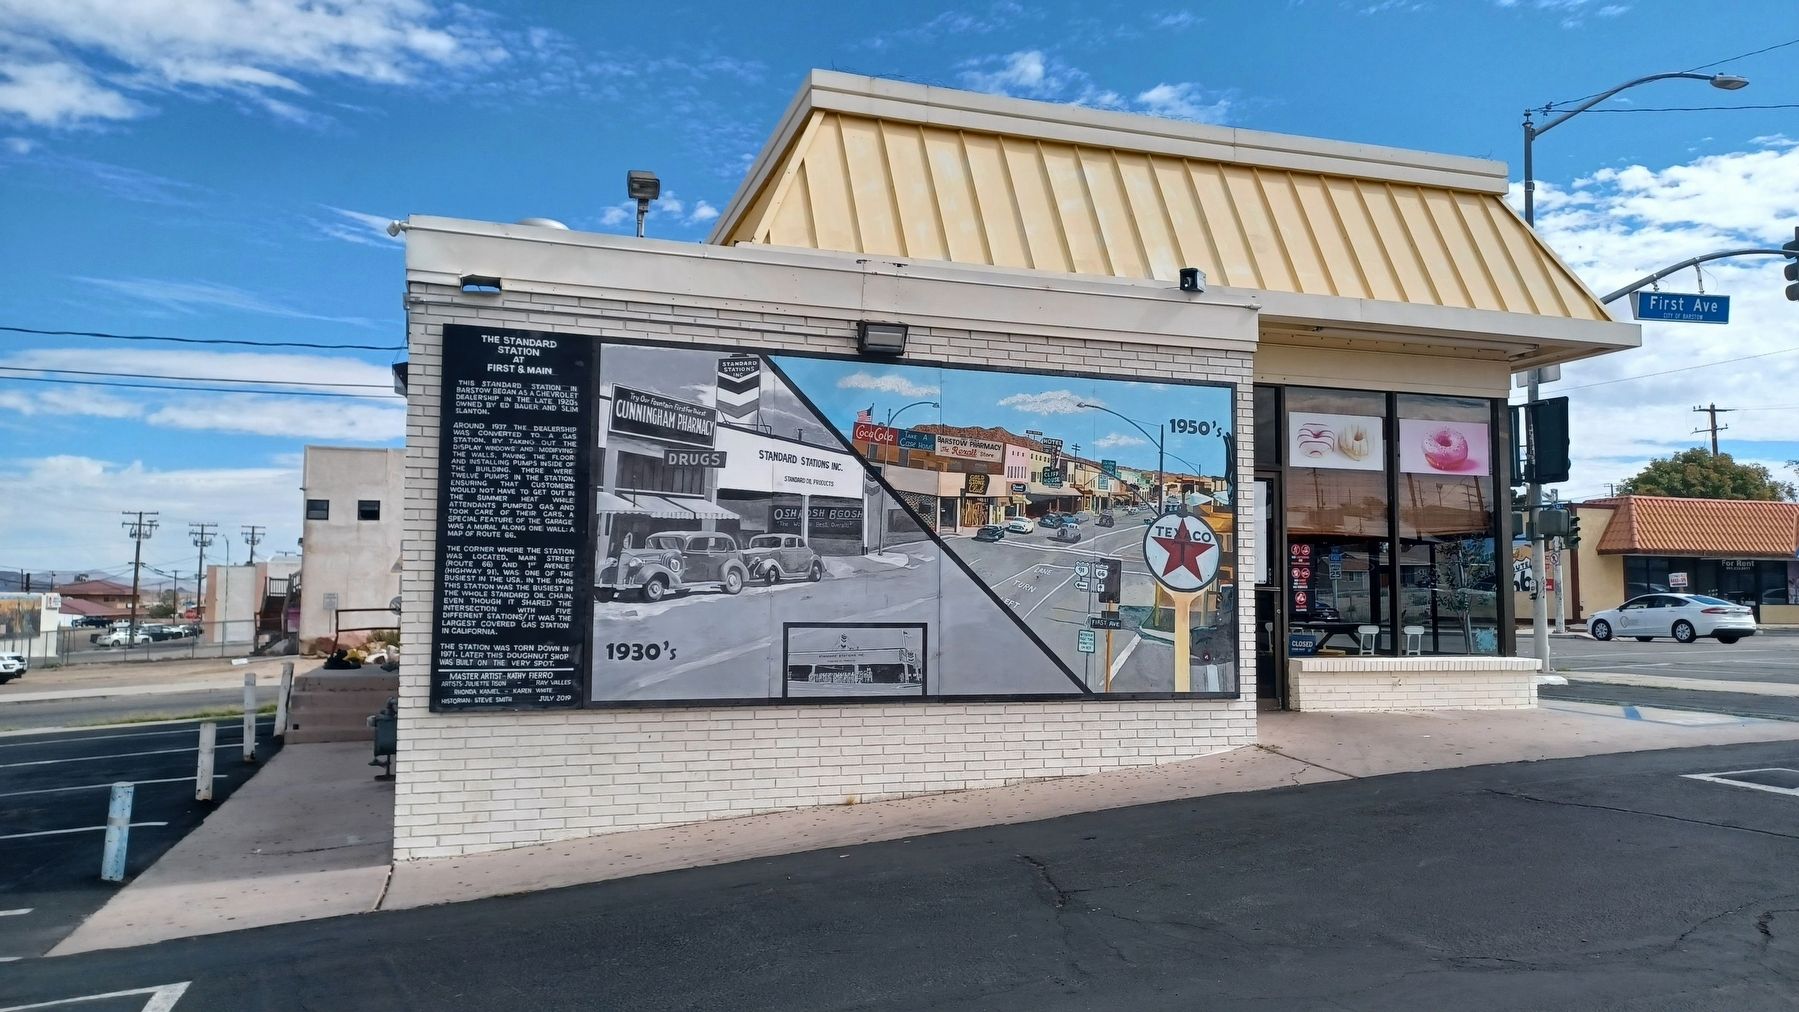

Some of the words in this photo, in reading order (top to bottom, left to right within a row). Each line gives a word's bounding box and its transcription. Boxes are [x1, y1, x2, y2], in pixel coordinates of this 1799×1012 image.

[1650, 296, 1684, 311] First
[1693, 298, 1718, 312] Ave
[481, 334, 499, 343] THE
[503, 336, 556, 348] STANDARD
[498, 345, 539, 356] STATION
[512, 355, 524, 363] AT
[487, 363, 514, 372] FIRST
[517, 365, 525, 373] &
[526, 366, 551, 375] MAIN
[481, 380, 521, 389] STANDARD
[531, 383, 560, 391] STATION
[455, 393, 499, 402] DEALERSHIP
[456, 386, 490, 394] BARSTOW
[492, 387, 516, 395] BEGAN
[536, 390, 577, 399] CHEVROLET
[630, 392, 639, 402] Try
[650, 398, 673, 410] Fountain
[616, 399, 676, 429] CUNNINGHAM
[677, 414, 714, 436] PHARMACY
[453, 421, 484, 429] AROUND
[533, 424, 576, 433] DEALERSHIP
[453, 428, 469, 436] WAS
[477, 429, 521, 438] CONVERTED
[1169, 418, 1222, 438] 1950's
[938, 436, 968, 446] BARSTOW
[969, 440, 1002, 451] PHARMACY
[1042, 438, 1062, 446] HOTEL
[951, 447, 978, 458] Rexall
[668, 452, 720, 466] DRUGS
[758, 450, 798, 464] STANDARD
[801, 456, 830, 470] STATIONS
[831, 462, 844, 472] INC.
[784, 476, 806, 484] STANDARD
[812, 478, 834, 487] PRODUCTS
[968, 484, 984, 494] Club
[449, 500, 496, 508] ATTENDANTS
[774, 508, 825, 520] OSHOSH
[1156, 526, 1212, 542] TEXCO
[1034, 566, 1054, 576] LANE
[1012, 580, 1036, 592] TURN
[1292, 640, 1314, 648] CLOSED
[606, 640, 676, 662] 1930's
